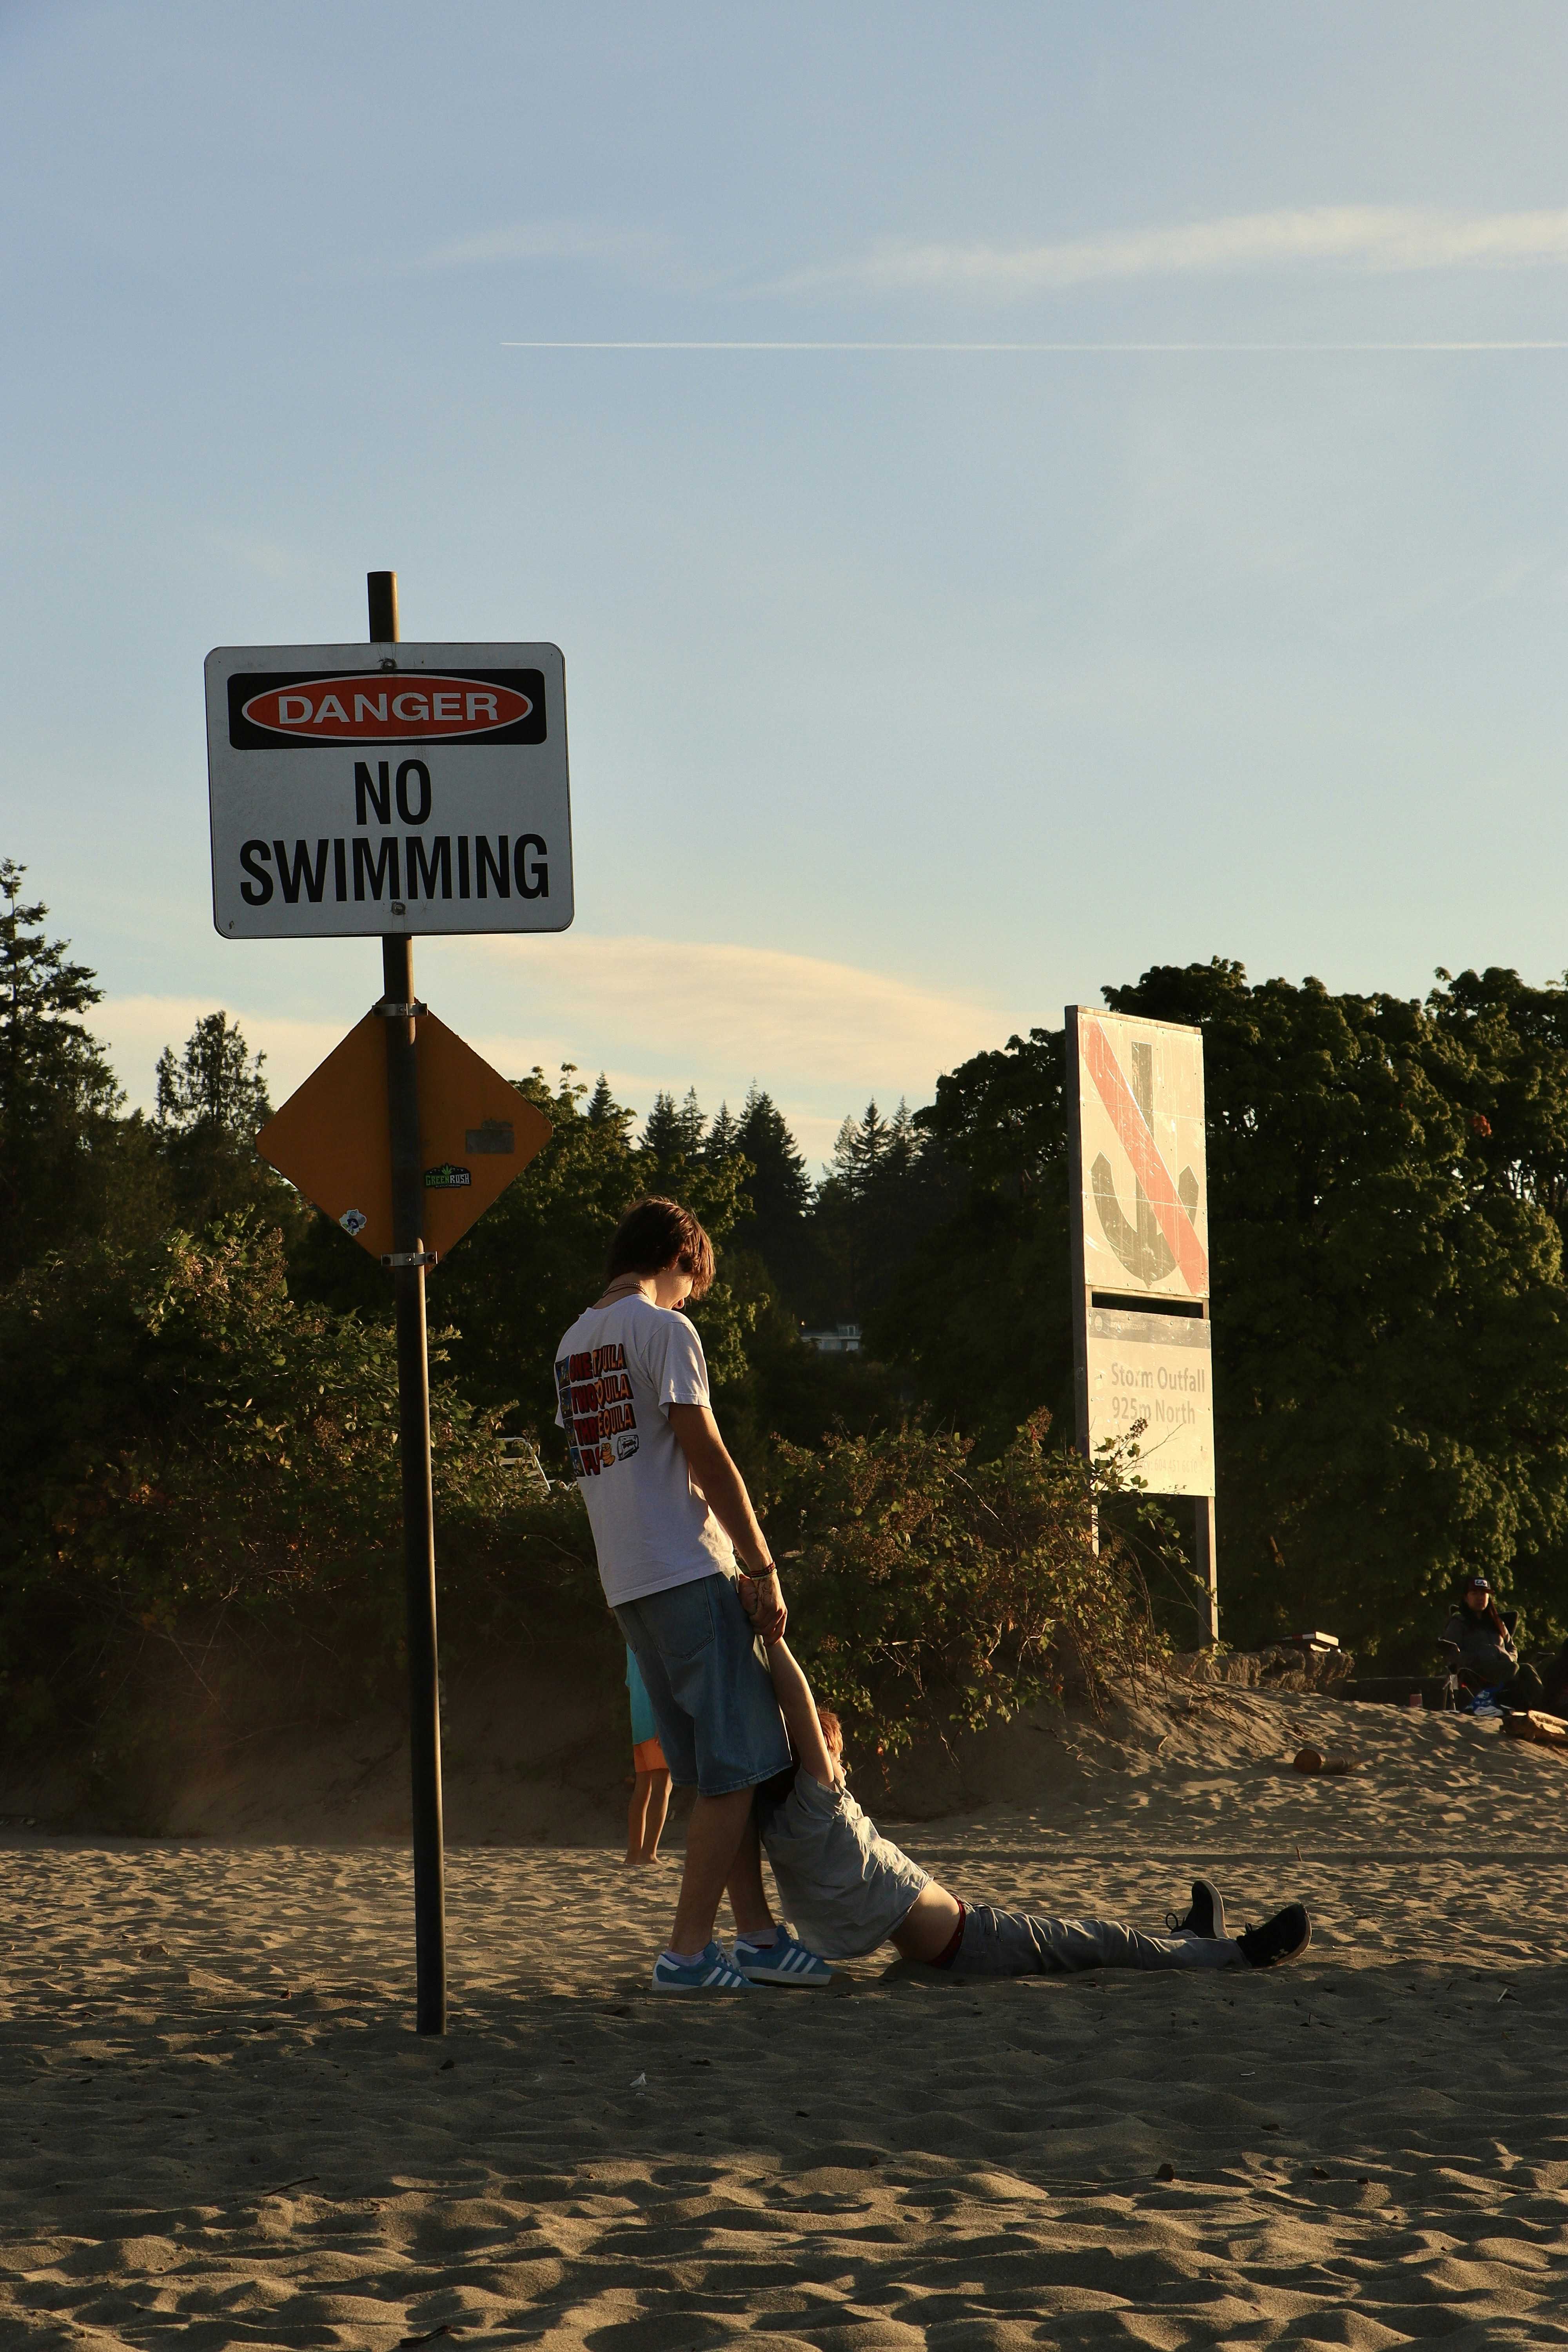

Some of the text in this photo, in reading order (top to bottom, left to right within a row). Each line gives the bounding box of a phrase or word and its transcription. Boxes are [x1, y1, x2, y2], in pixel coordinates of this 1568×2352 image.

[278, 692, 499, 724] DANGER
[354, 759, 432, 826] NO
[240, 833, 549, 906] SWIMMING
[570, 1352, 593, 1383] ONE
[1111, 1362, 1205, 1393] Storm Outfall
[571, 1383, 599, 1414] TWO
[1112, 1396, 1196, 1425] 925m North
[1154, 1458, 1166, 1471] 604
[1168, 1459, 1180, 1472] 451
